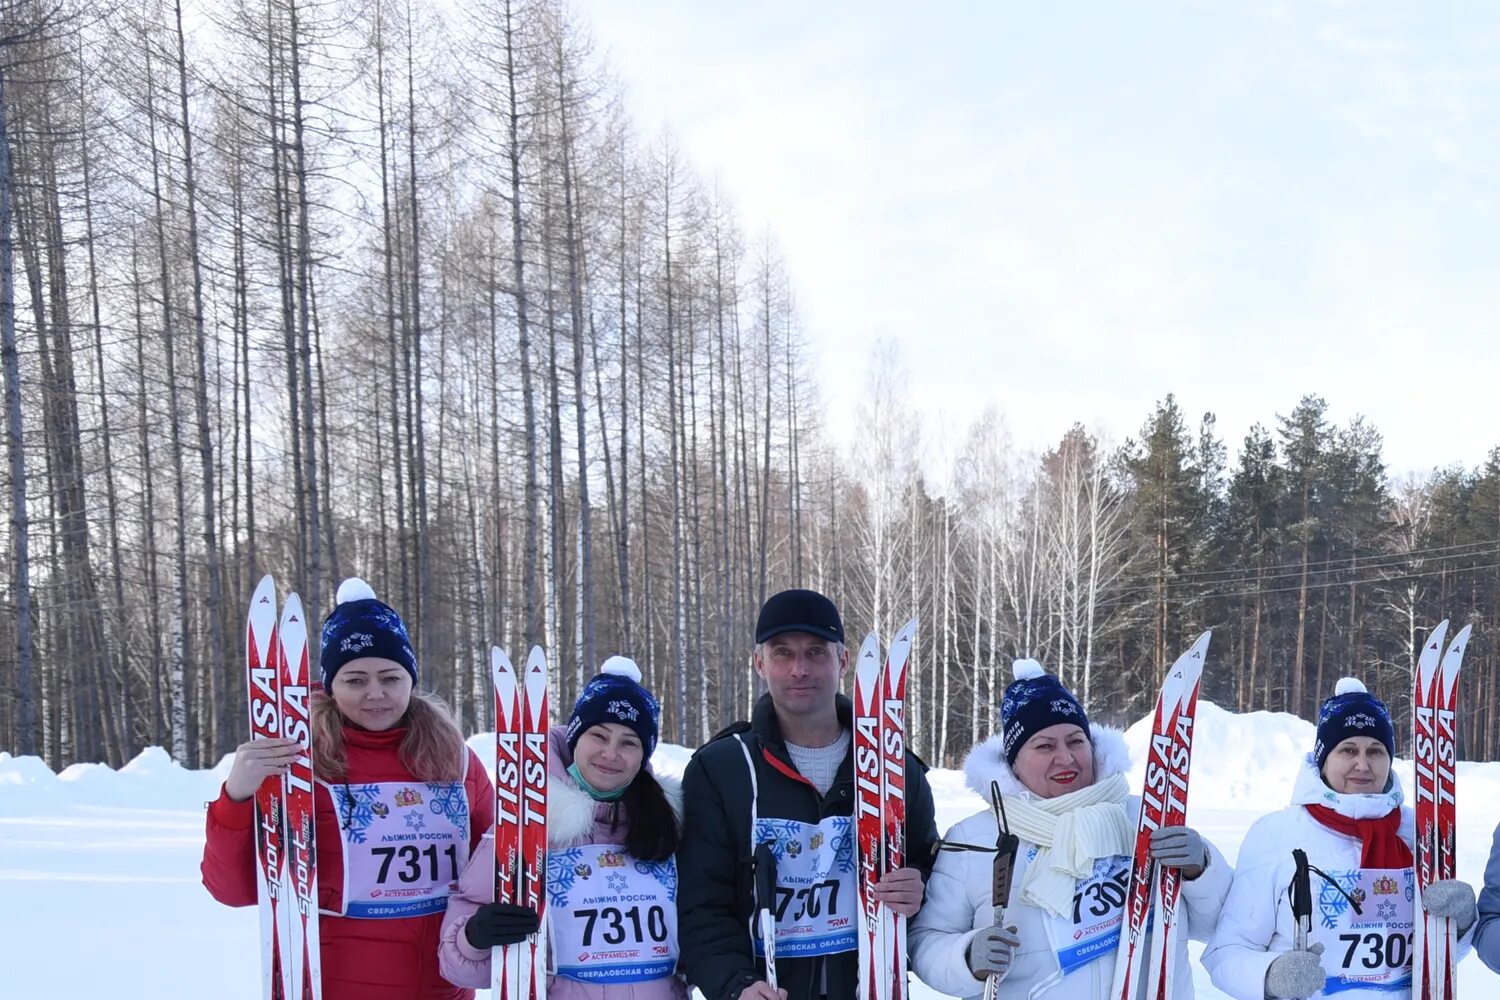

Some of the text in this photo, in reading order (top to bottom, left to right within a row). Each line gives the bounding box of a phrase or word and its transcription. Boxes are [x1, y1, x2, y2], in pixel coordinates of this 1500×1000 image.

[251, 667, 279, 741] SA
[857, 716, 880, 820] TISA
[884, 698, 904, 802] TISA
[1167, 715, 1192, 815] TISA
[1416, 706, 1434, 804] TISA
[1438, 708, 1455, 806] TISA
[498, 733, 518, 825] TISA
[524, 733, 545, 826] TISA
[1140, 734, 1171, 834] TISA
[381, 832, 453, 843] ЛЫЖНЯ РОССИИ
[371, 844, 459, 884] 7311
[367, 903, 432, 914] СВЕРДЛОВСКАЯ
[583, 894, 657, 904] ЛЫЖНЯ РОССИИ
[775, 880, 840, 922] 7307
[1163, 867, 1175, 928] spor
[573, 905, 668, 947] 7310
[776, 938, 855, 952] ЛОВСКАЯ ОБЛАСТЬ
[1076, 935, 1120, 956] СВЕРДЛОВС
[1350, 922, 1383, 930] ЛЫЖНЯ
[577, 968, 642, 978] СВЕРДЛОВСКАЯ
